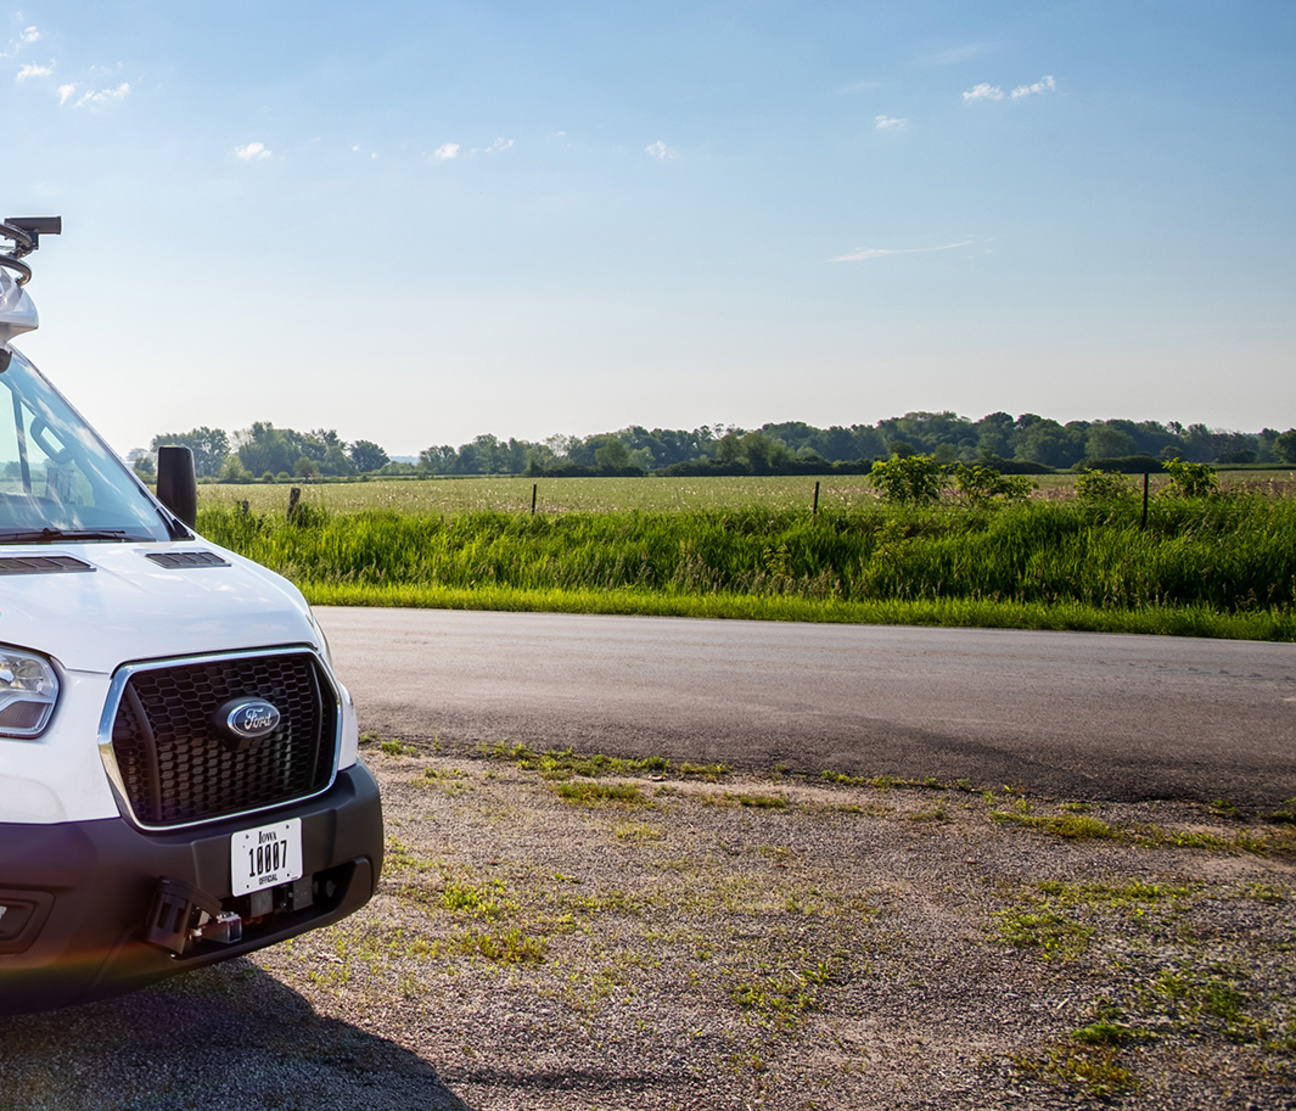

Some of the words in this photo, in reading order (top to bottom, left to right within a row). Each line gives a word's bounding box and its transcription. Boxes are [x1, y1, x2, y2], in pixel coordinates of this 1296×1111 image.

[244, 708, 271, 730] Ford
[249, 839, 287, 877] 10007
[259, 874, 278, 885] OFFICIAL
